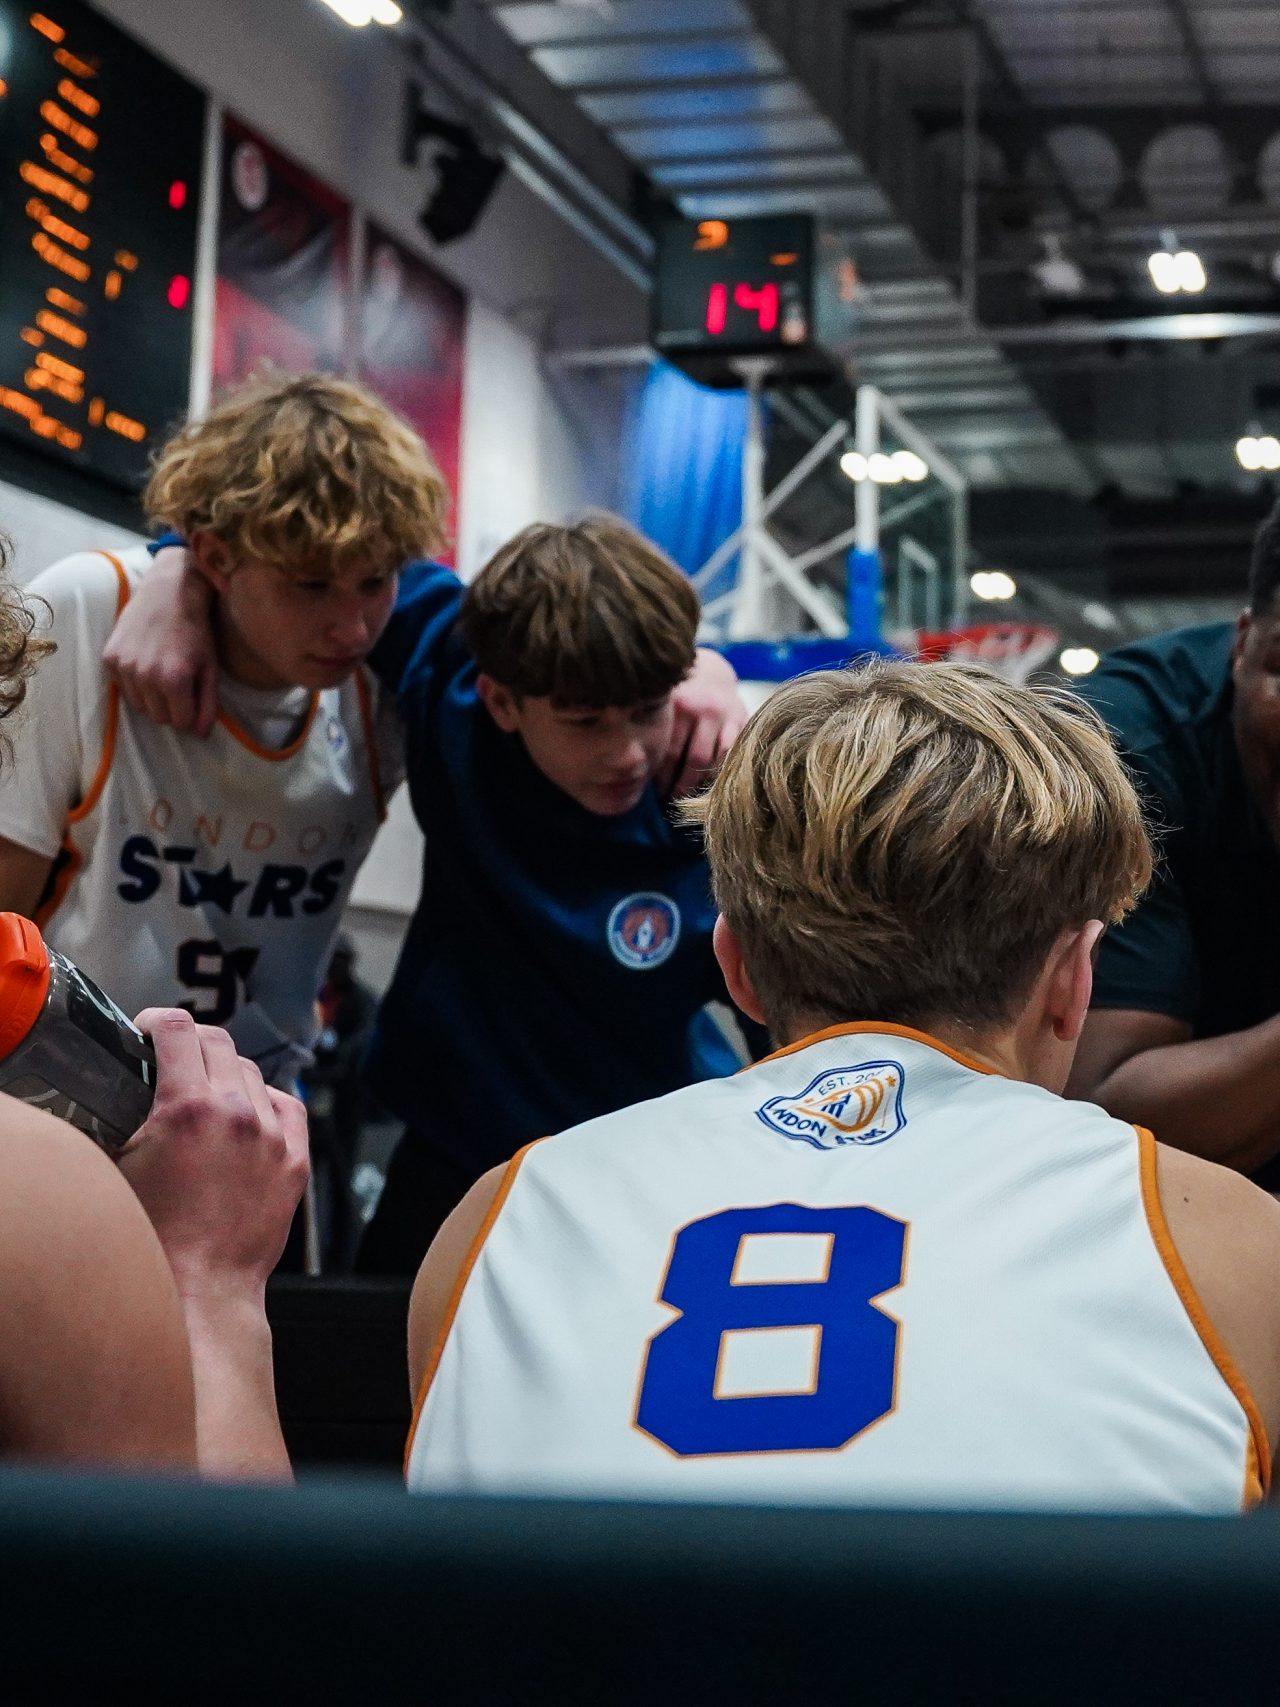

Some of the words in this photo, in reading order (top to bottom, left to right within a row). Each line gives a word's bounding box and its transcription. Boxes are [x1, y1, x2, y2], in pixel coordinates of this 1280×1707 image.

[706, 282, 779, 335] 14
[772, 1108, 827, 1138] NDON
[631, 1200, 911, 1460] 8
